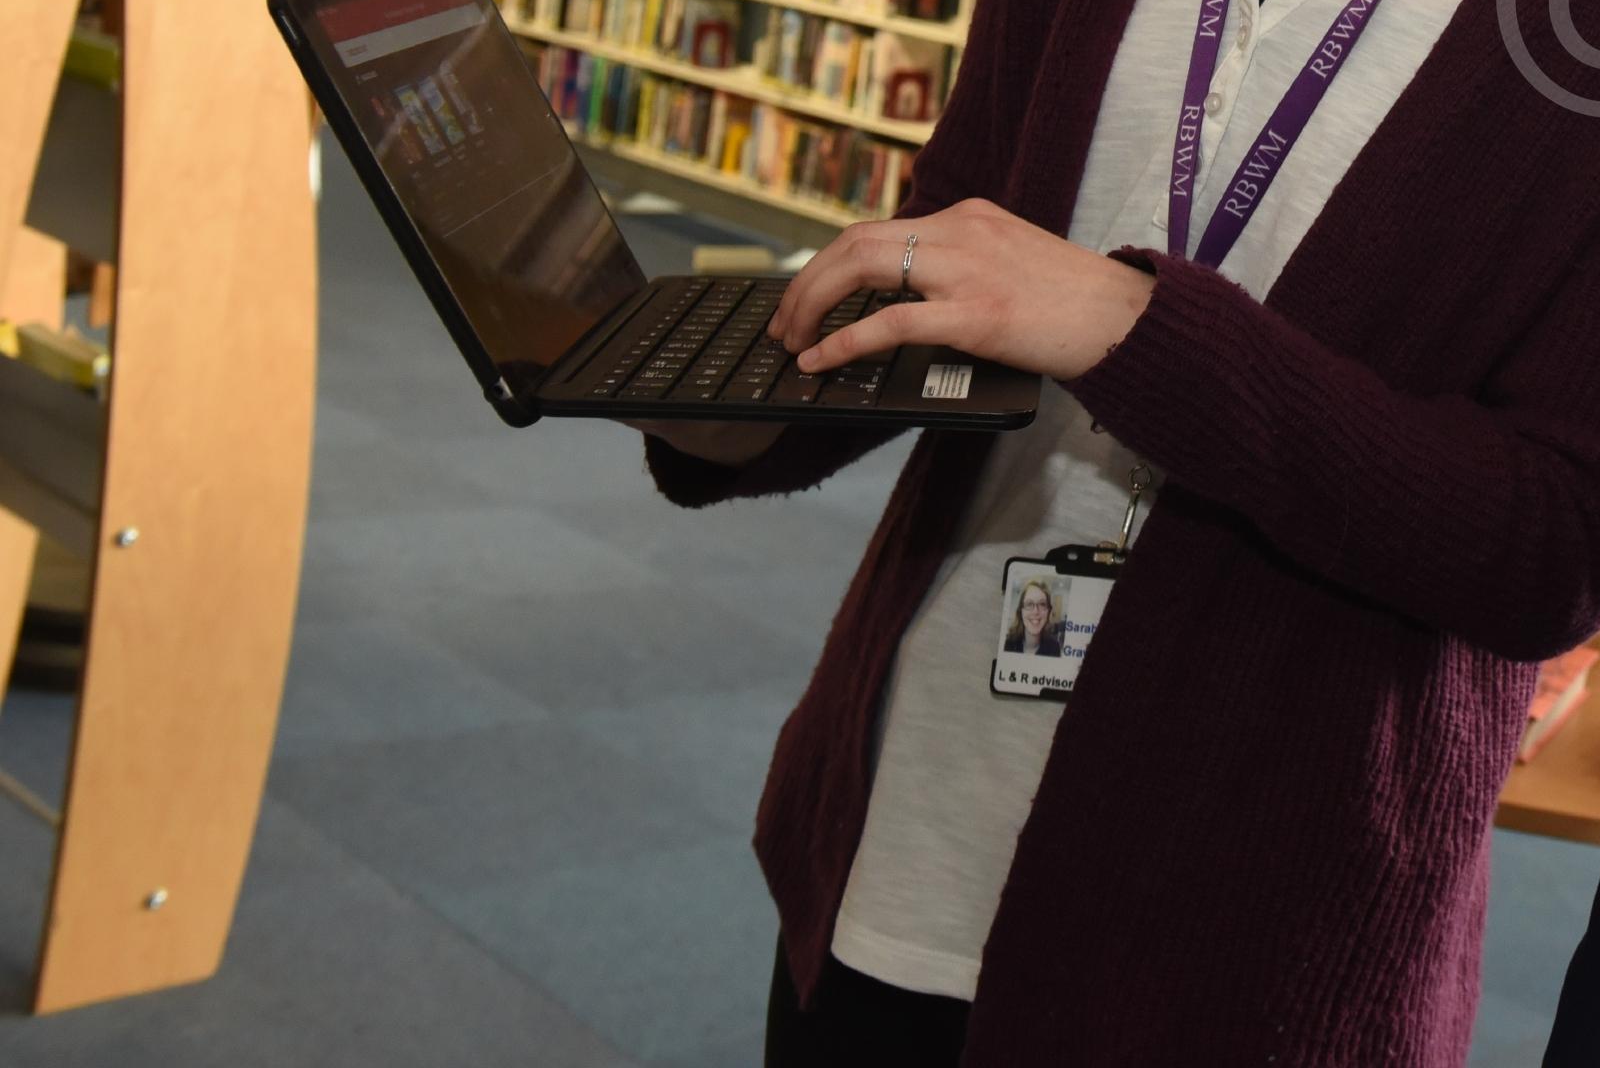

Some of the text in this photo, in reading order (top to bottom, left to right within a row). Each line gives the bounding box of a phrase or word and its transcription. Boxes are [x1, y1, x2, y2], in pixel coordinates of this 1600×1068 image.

[1172, 104, 1200, 199] RBWM
[1224, 128, 1288, 219] RBWM
[999, 670, 1073, 688] L & R advisor
